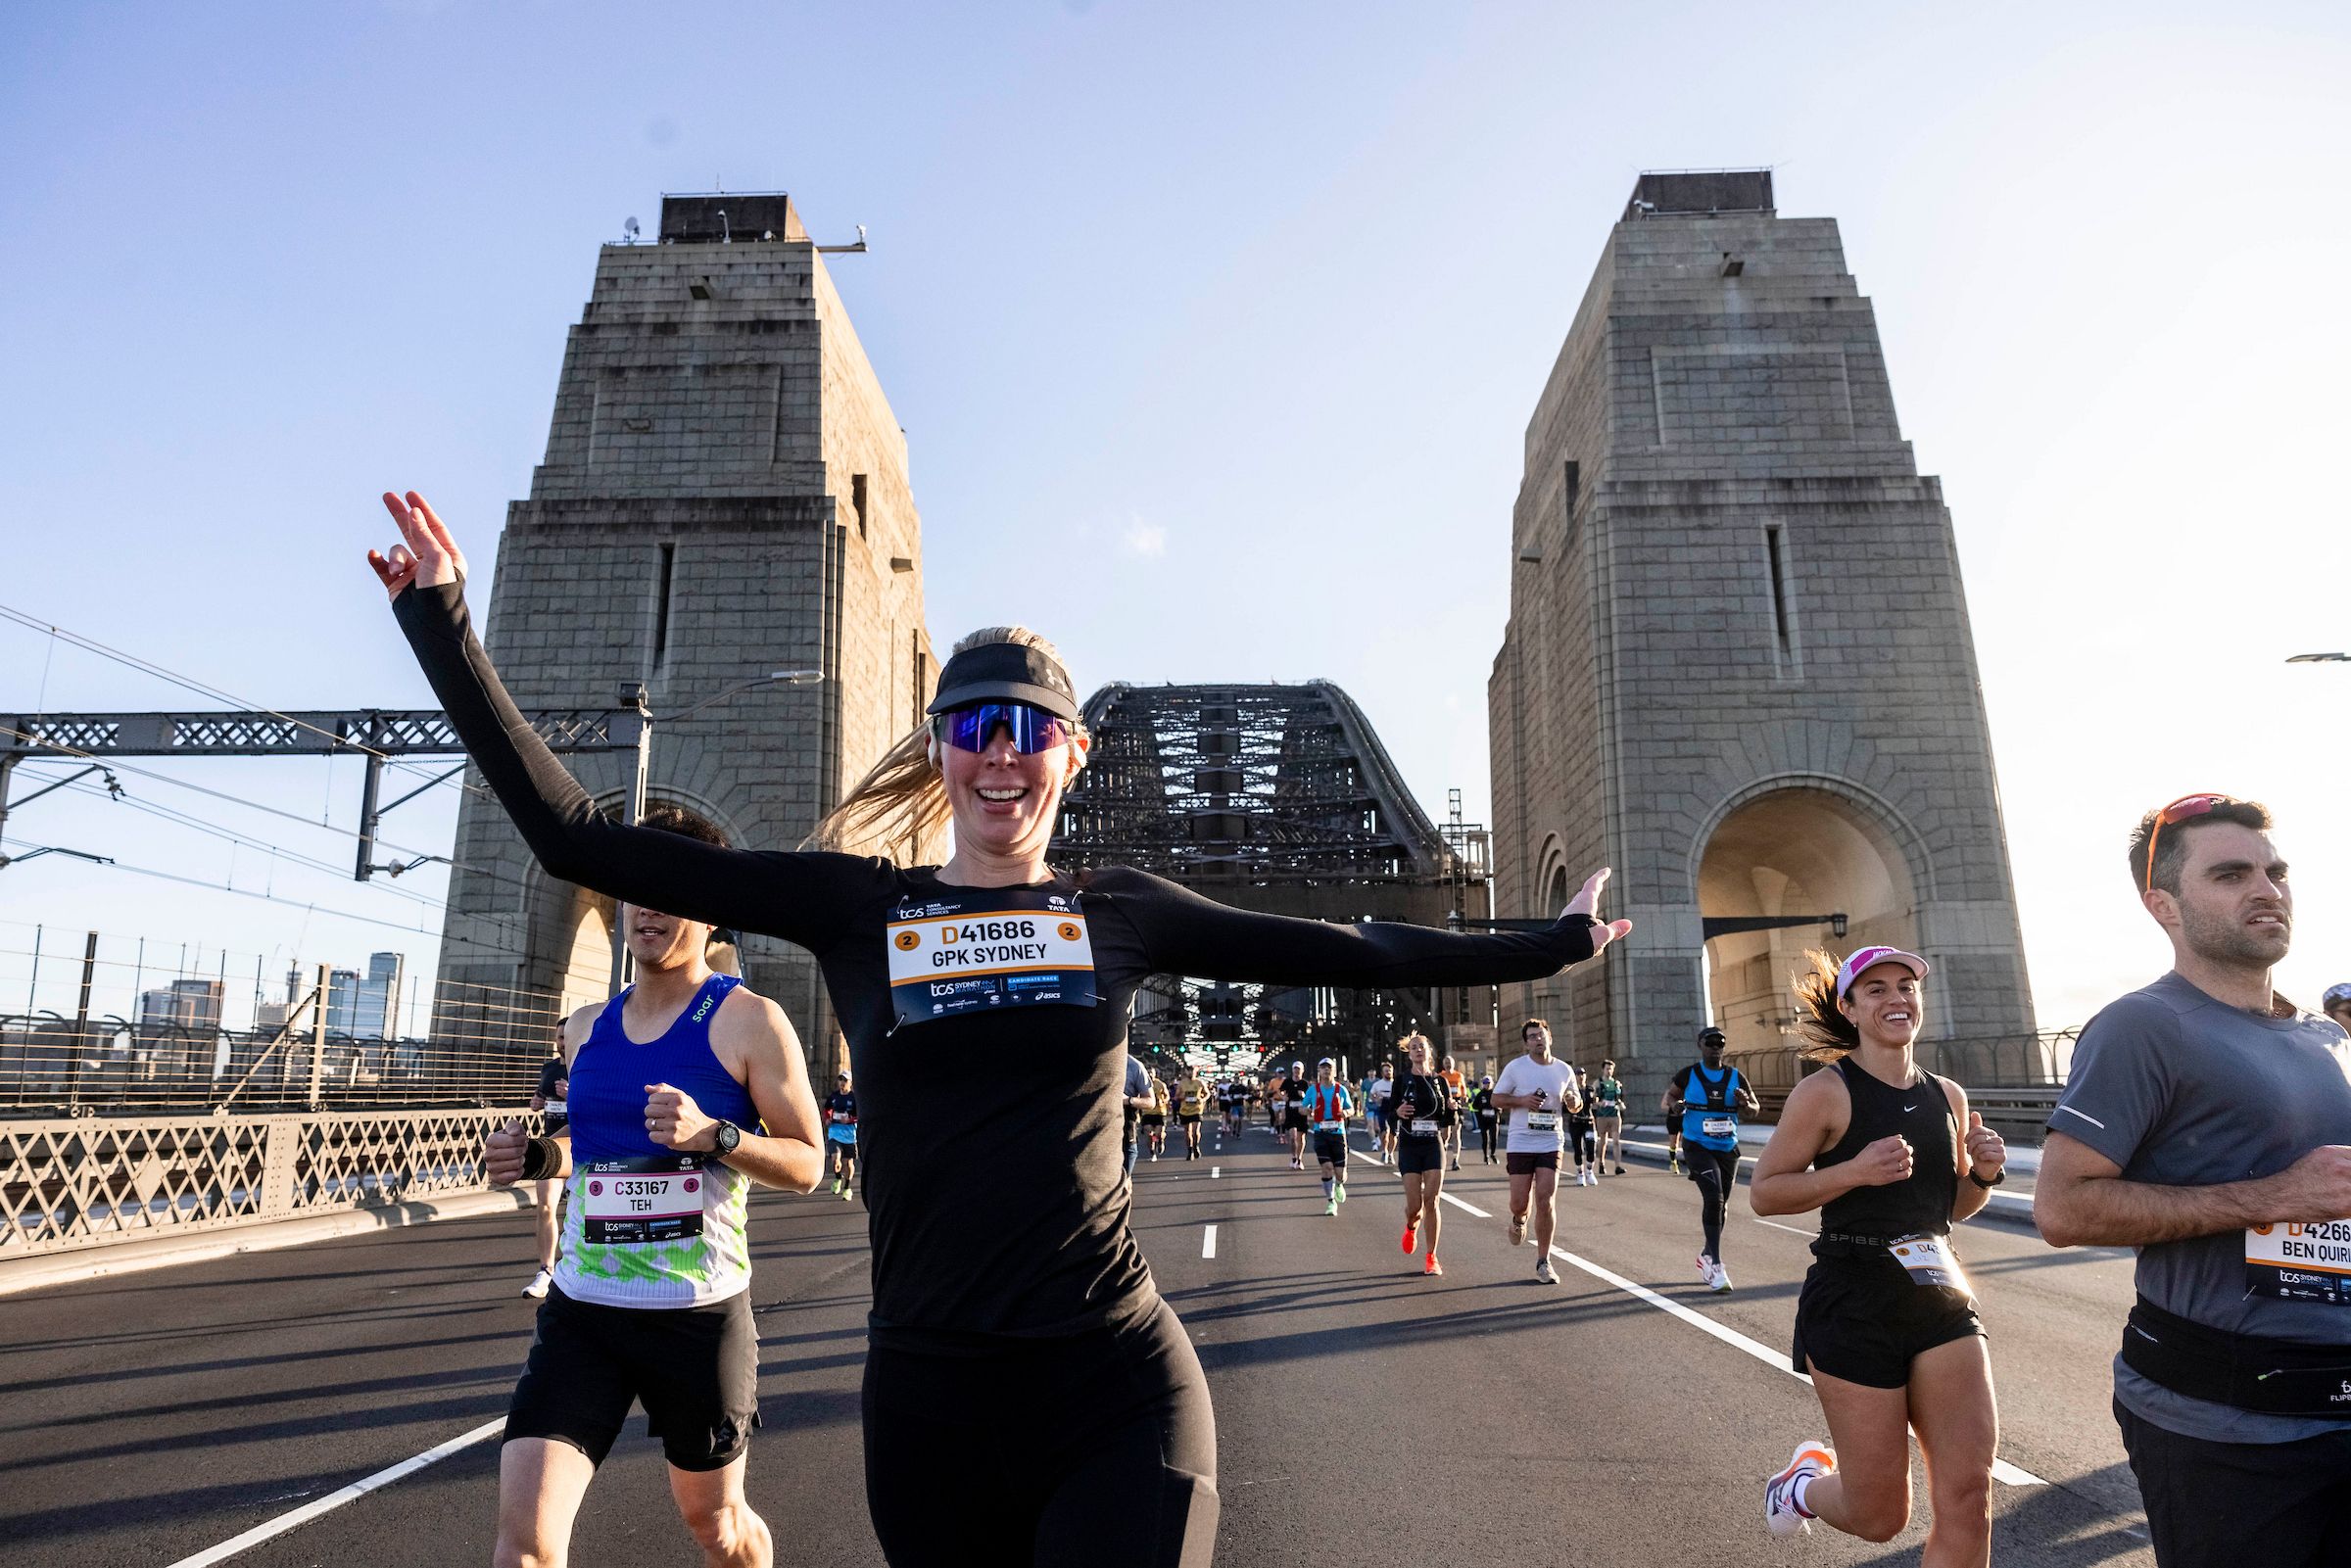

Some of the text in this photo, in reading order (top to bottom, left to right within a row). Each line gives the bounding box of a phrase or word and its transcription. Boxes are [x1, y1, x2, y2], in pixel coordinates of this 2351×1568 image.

[900, 907, 924, 920] tcs
[926, 905, 961, 914] CONSULTANCY
[941, 921, 1035, 945] D41686
[1065, 927, 1075, 936] 2
[903, 935, 912, 946] 2
[933, 943, 1047, 968] GPK SYDNEY
[931, 980, 981, 997] tcs SYDNEY
[955, 983, 996, 994] MARATHON
[692, 994, 714, 1023] soar
[594, 1162, 608, 1172] tcs
[615, 1180, 669, 1196] C33167
[630, 1199, 651, 1211] TEH
[604, 1221, 619, 1231] tcs
[1830, 1233, 1884, 1246] SPIBE
[2282, 1240, 2315, 1259] BEN
[2279, 1269, 2300, 1283] tcs
